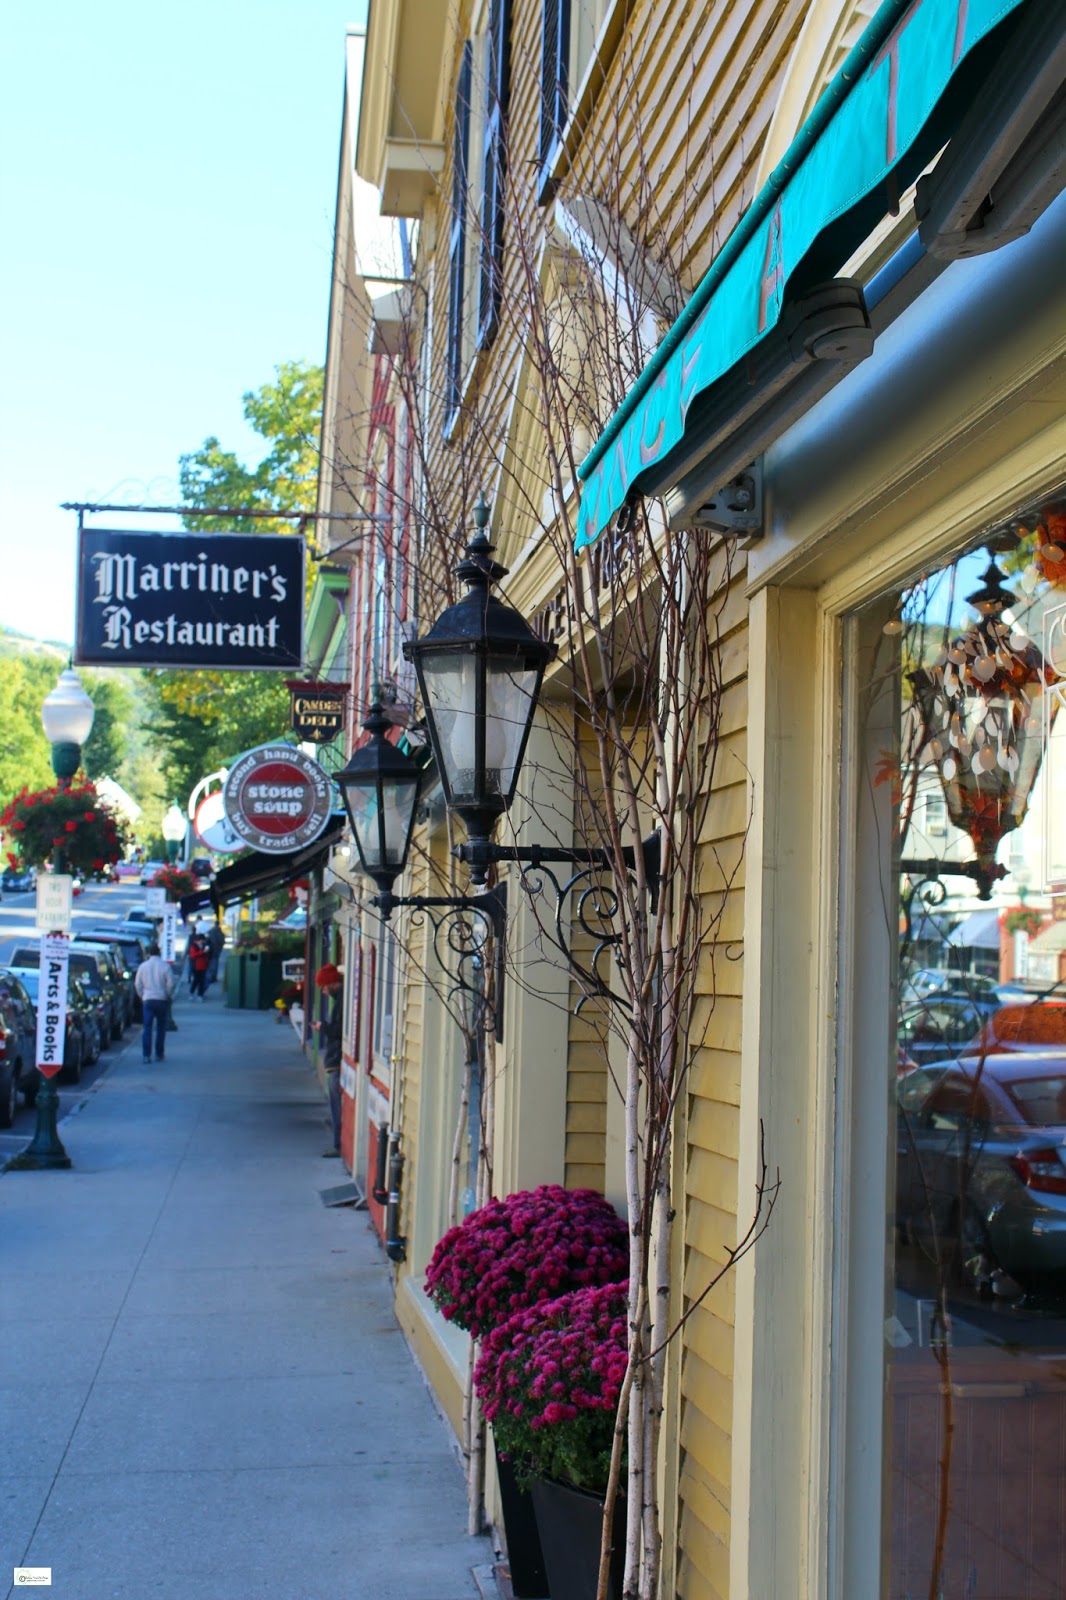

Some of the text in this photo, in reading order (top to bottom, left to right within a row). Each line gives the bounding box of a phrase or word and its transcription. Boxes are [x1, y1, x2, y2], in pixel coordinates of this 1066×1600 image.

[91, 552, 287, 603] Marriner's
[101, 606, 280, 649] Restaurant
[300, 715, 337, 726] DELI
[229, 750, 326, 798] second hand books
[248, 784, 304, 798] stone
[253, 801, 302, 816] soup
[231, 812, 323, 848] buy trade sell
[47, 962, 62, 998] Arts
[47, 1000, 59, 1012] &
[43, 1016, 59, 1062] Books
